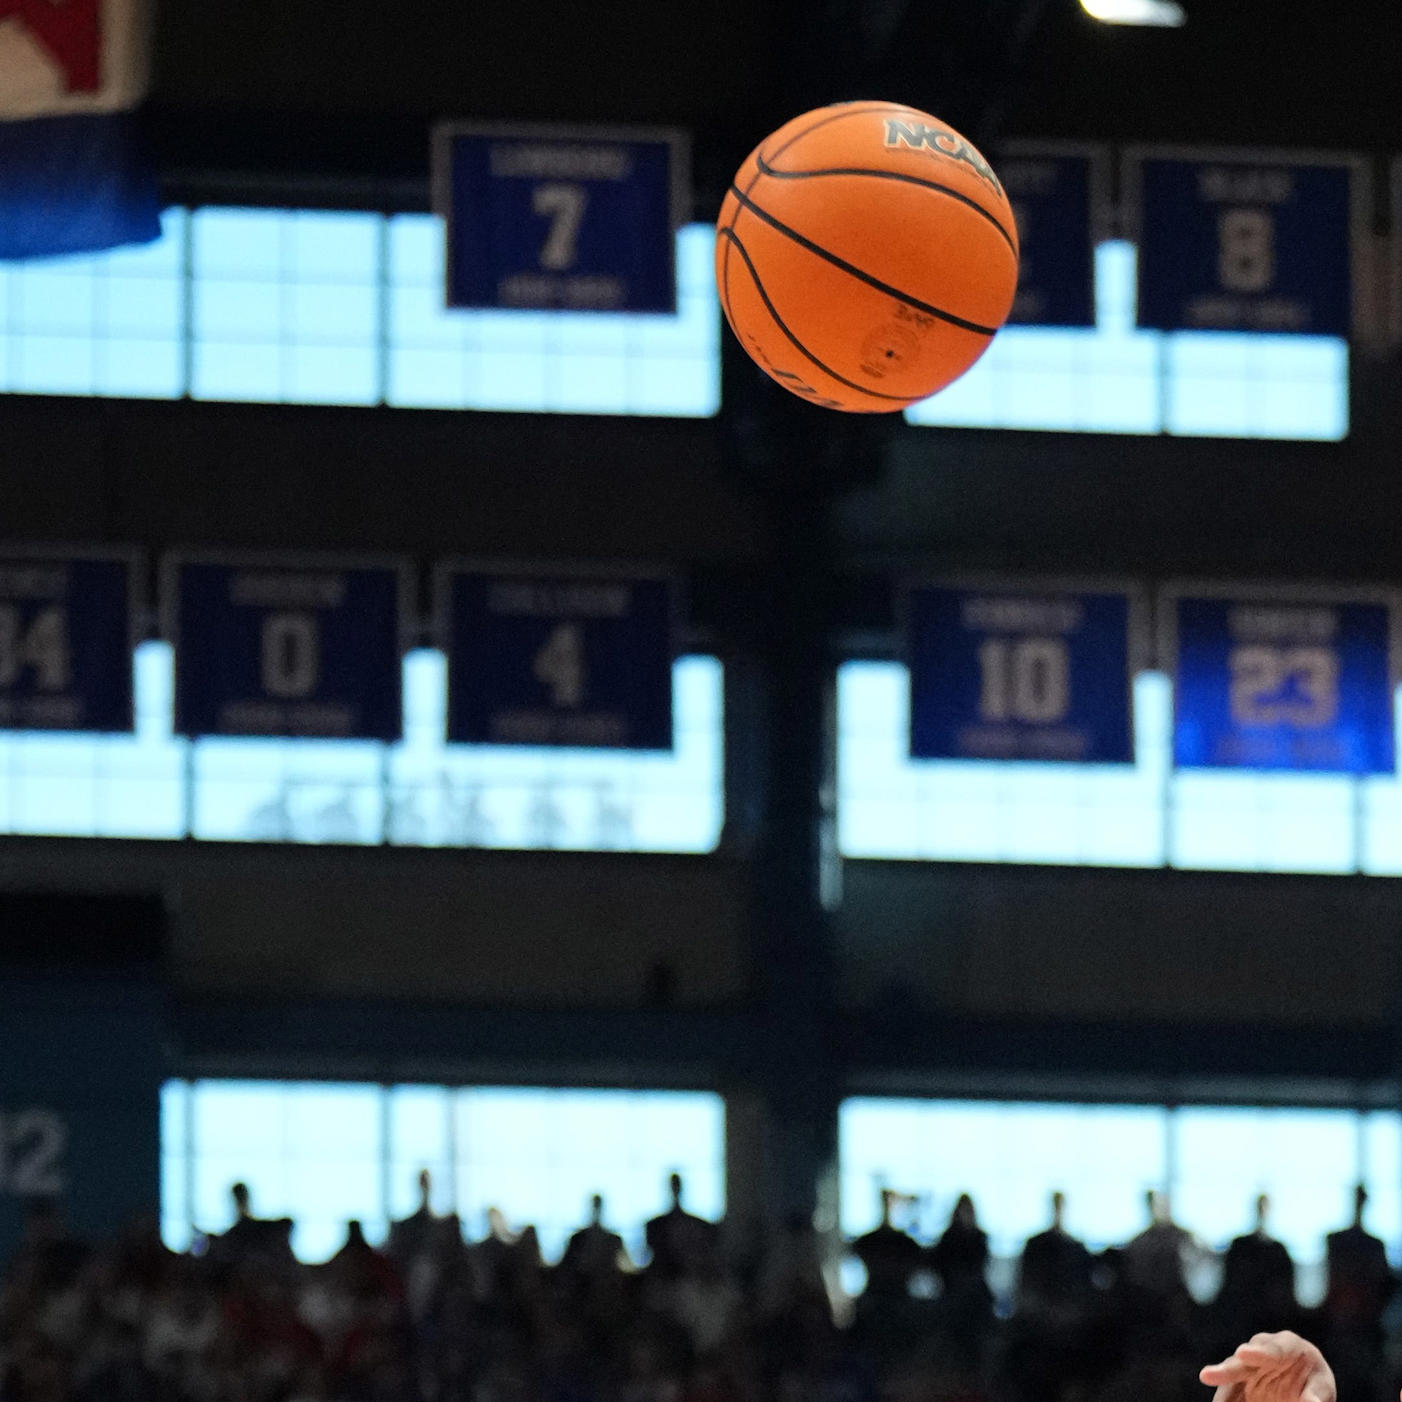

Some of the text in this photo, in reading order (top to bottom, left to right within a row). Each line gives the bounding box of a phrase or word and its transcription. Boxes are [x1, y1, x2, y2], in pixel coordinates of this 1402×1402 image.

[531, 184, 590, 271] 7
[978, 637, 1070, 722] 10
[1229, 645, 1340, 729] 23
